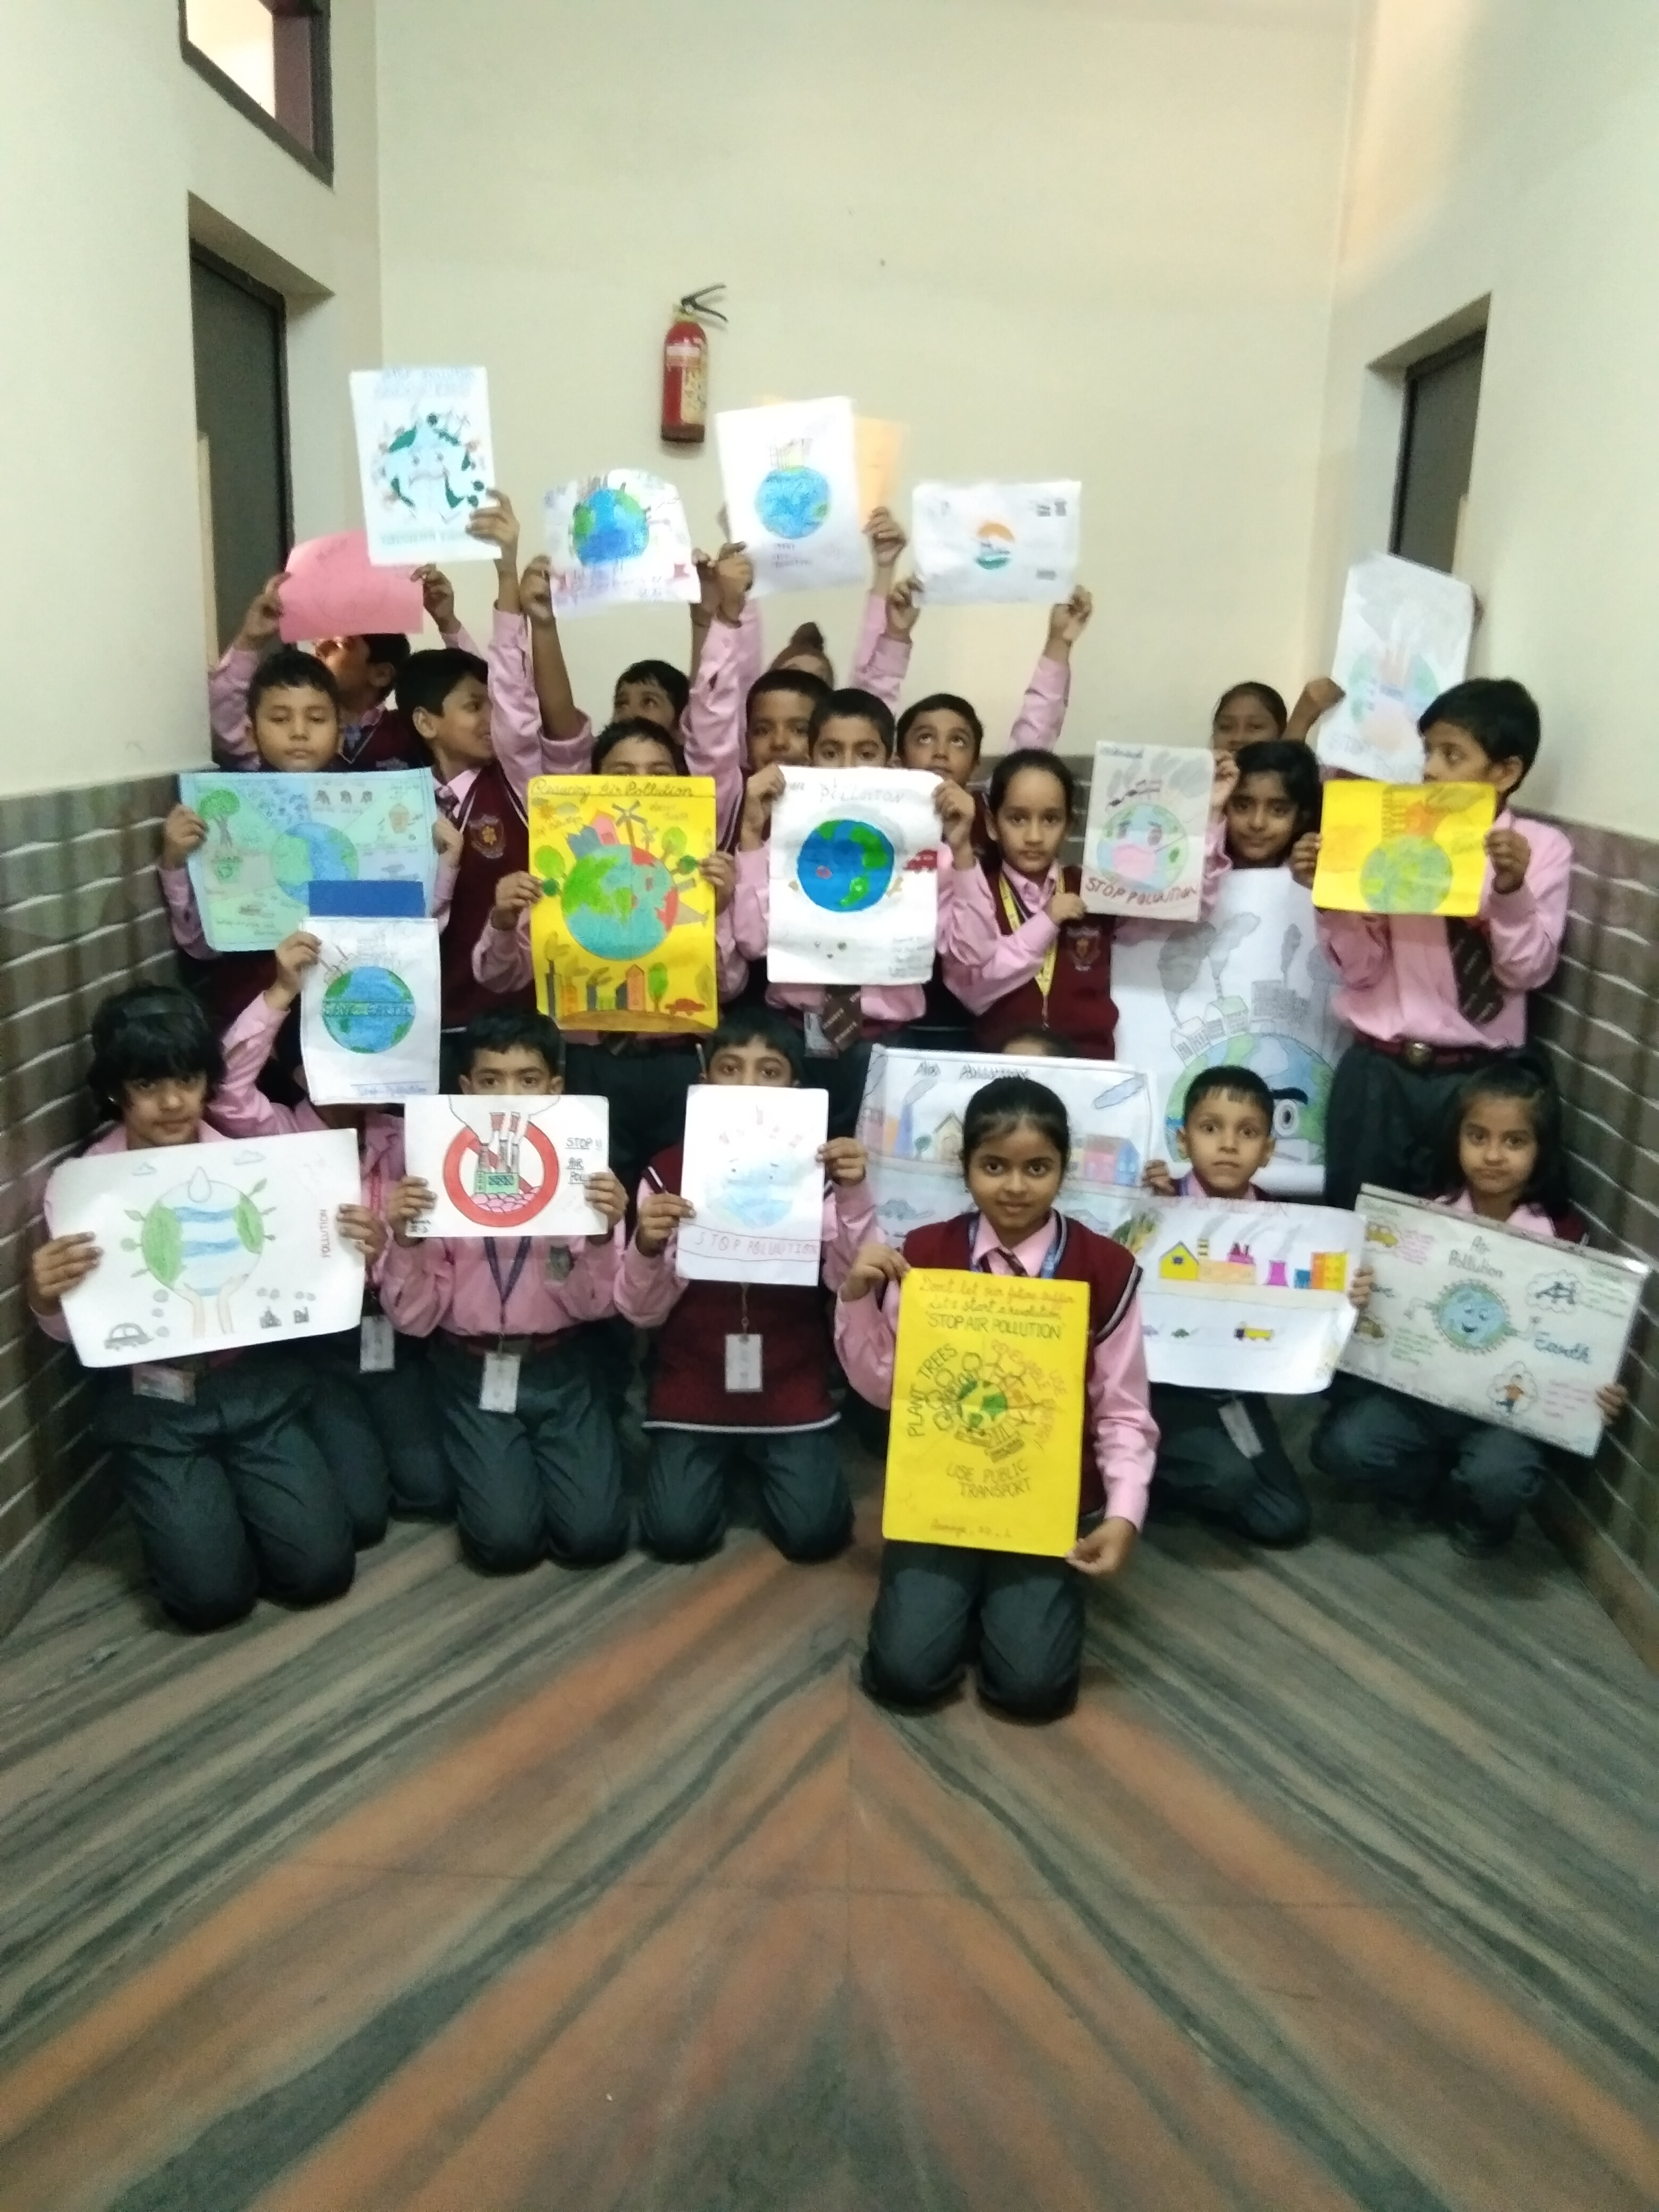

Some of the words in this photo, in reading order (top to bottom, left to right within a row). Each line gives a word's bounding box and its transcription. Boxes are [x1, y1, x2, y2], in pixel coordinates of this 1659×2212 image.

[625, 780, 694, 797] Pollution
[1085, 876, 1126, 899] STOP
[566, 1136, 593, 1149] STOP
[566, 1156, 584, 1169] AIR
[319, 1209, 331, 1259] POLLUTION
[694, 1231, 742, 1251] STOP
[926, 1312, 965, 1330] STOP
[964, 1316, 989, 1333] AIR
[992, 1318, 1063, 1341] POLLUTION
[915, 1342, 959, 1380] TREES
[906, 1382, 930, 1438] PLANT
[946, 1460, 974, 1482] USE
